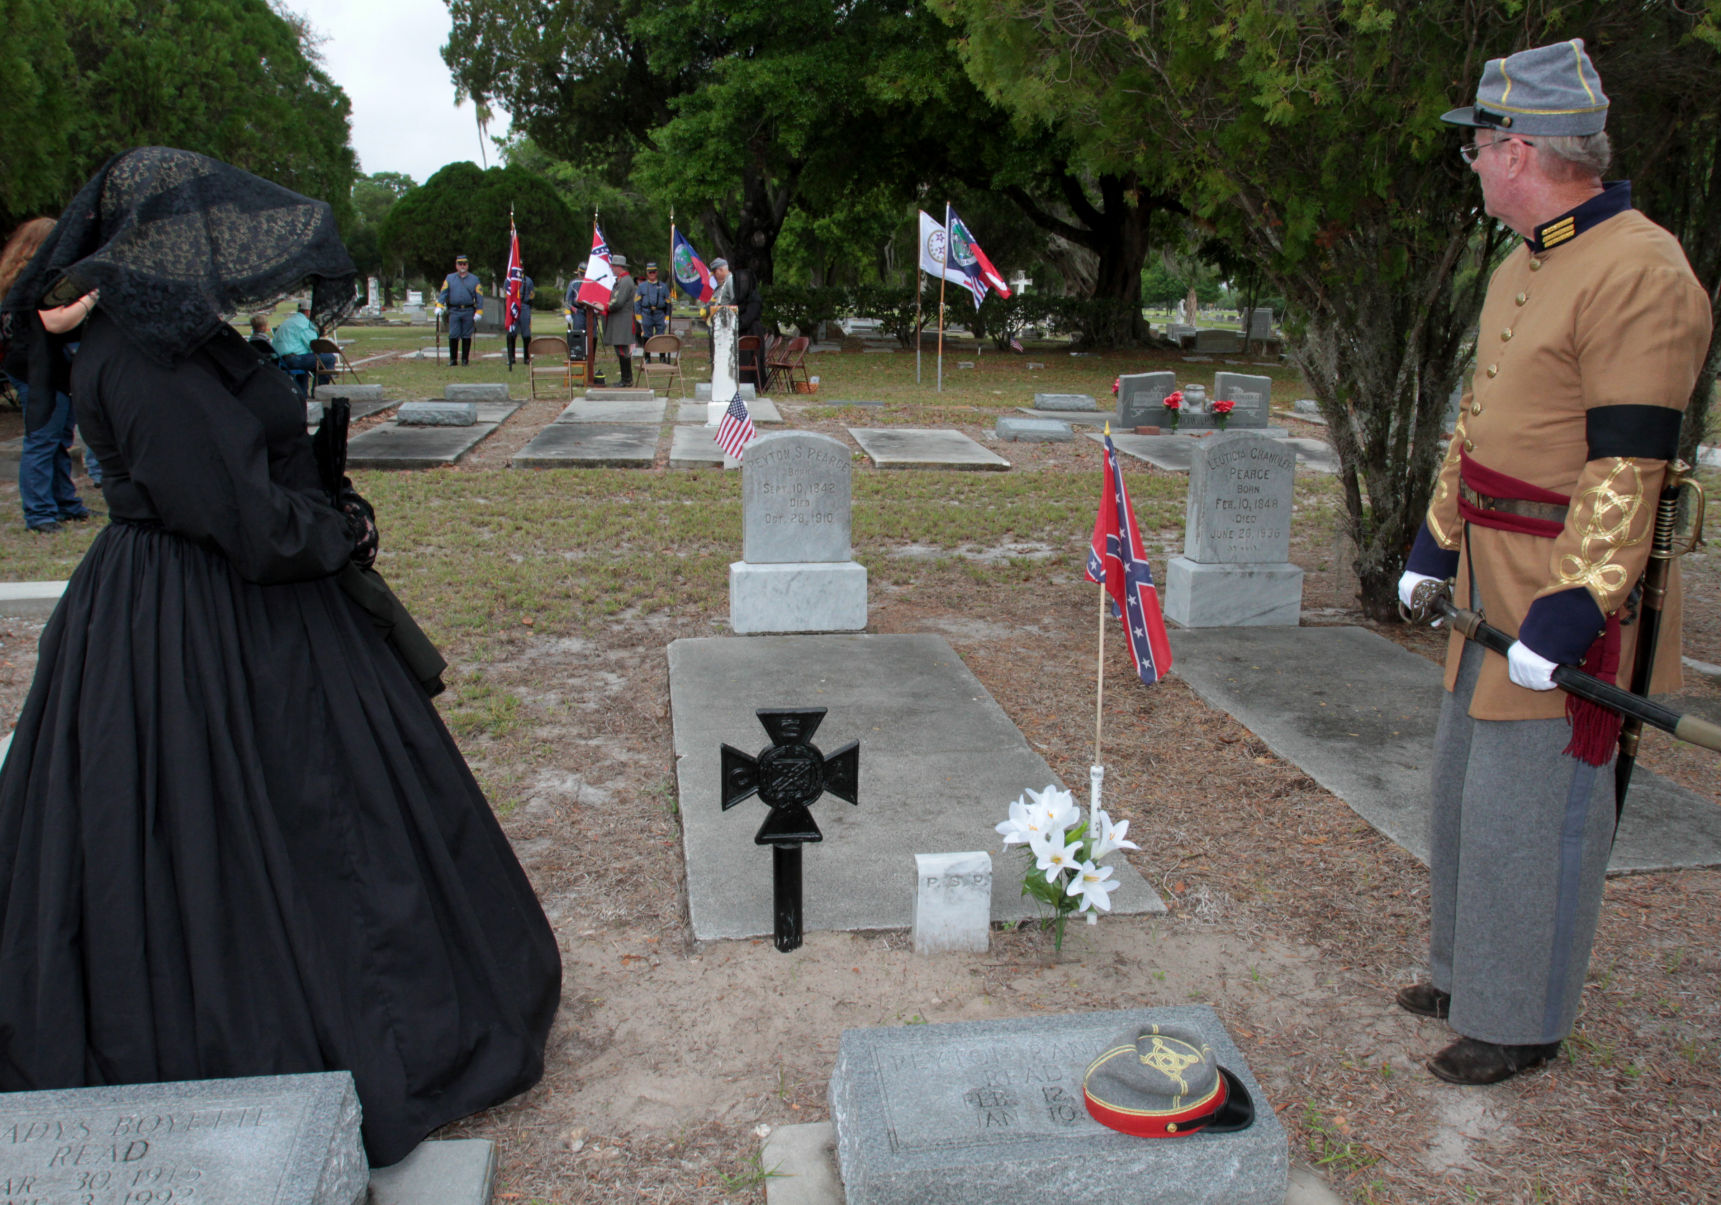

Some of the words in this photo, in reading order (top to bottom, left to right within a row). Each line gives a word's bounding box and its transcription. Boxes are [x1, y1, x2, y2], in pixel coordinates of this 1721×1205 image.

[748, 447, 790, 468] PEYTON
[808, 447, 851, 473] PEARCE
[1250, 447, 1293, 473] CHANDLER
[1230, 467, 1271, 480] PEARCE
[809, 482, 836, 494] 1842
[1237, 484, 1261, 495] BORN
[1238, 498, 1252, 513] 10,
[1254, 497, 1279, 510] 1848
[1235, 513, 1257, 524] DIED
[1210, 529, 1234, 540] JUNE
[49, 1140, 150, 1168] READ
